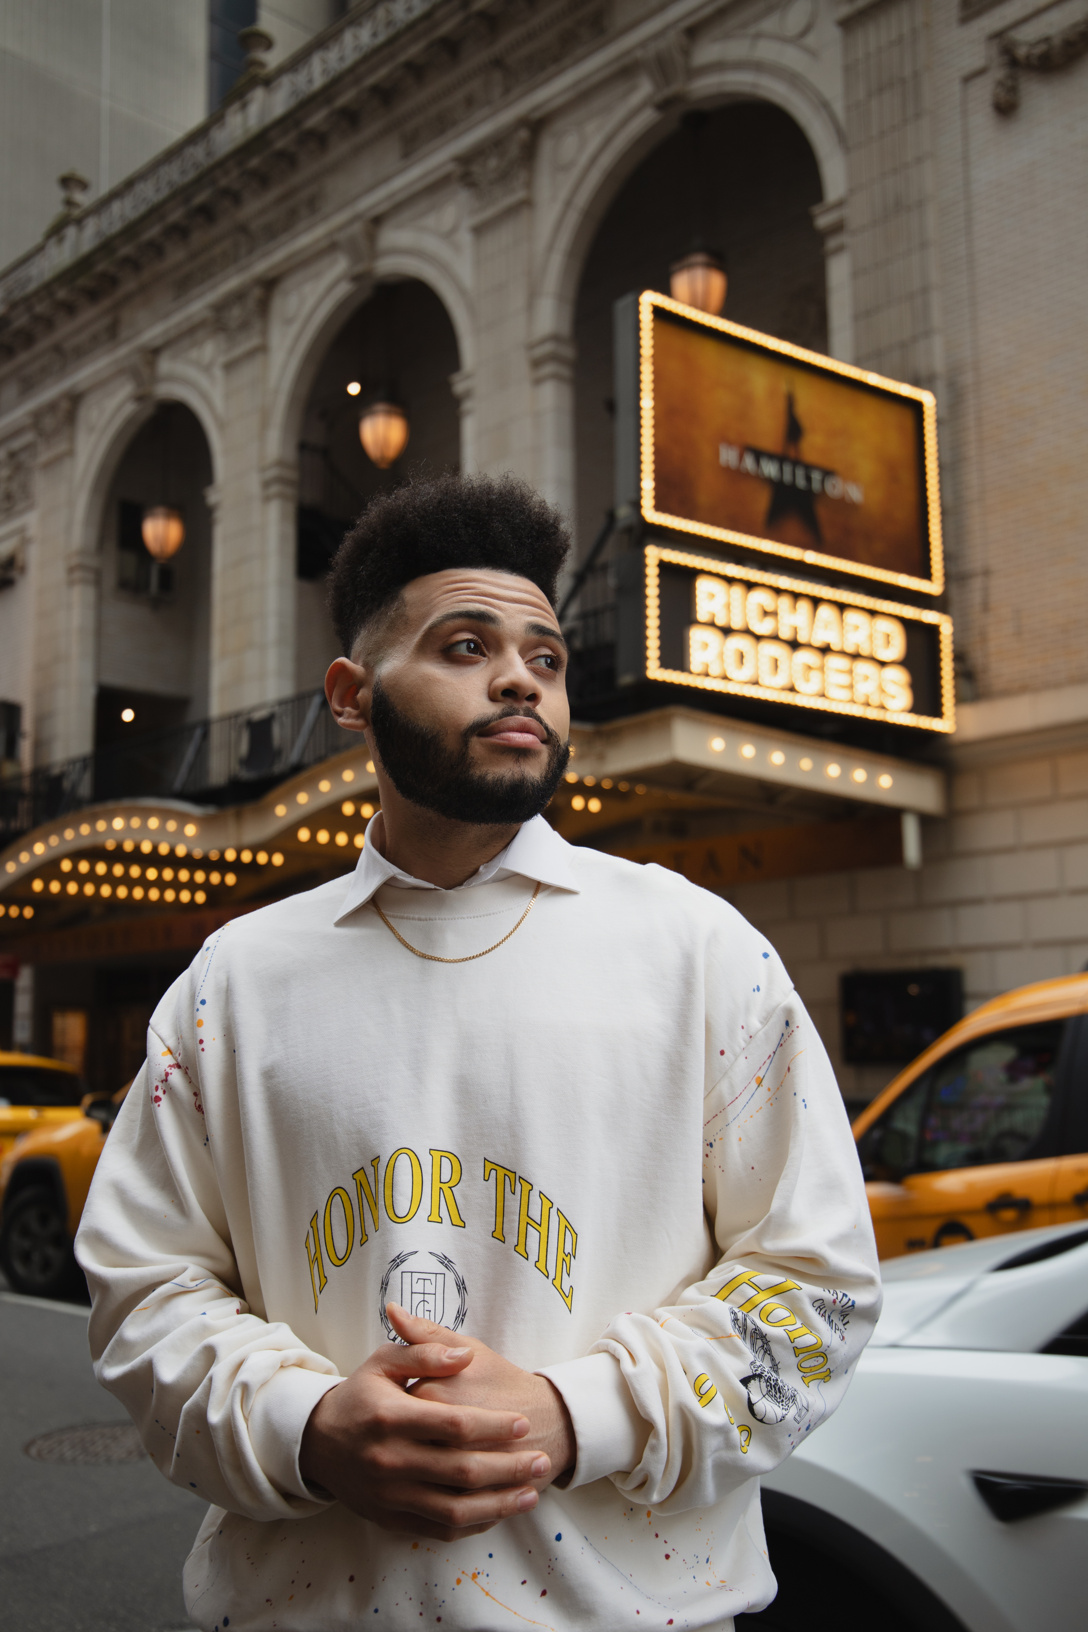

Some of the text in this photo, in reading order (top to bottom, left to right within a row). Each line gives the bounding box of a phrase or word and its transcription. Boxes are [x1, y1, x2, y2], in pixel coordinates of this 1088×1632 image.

[719, 442, 864, 504] HAMILTON
[695, 574, 907, 662] RICHARD
[689, 623, 914, 712] RODGERS
[305, 1147, 578, 1314] HONOR THE
[710, 1270, 831, 1388] Honor
[812, 1298, 845, 1341] CHAMPS
